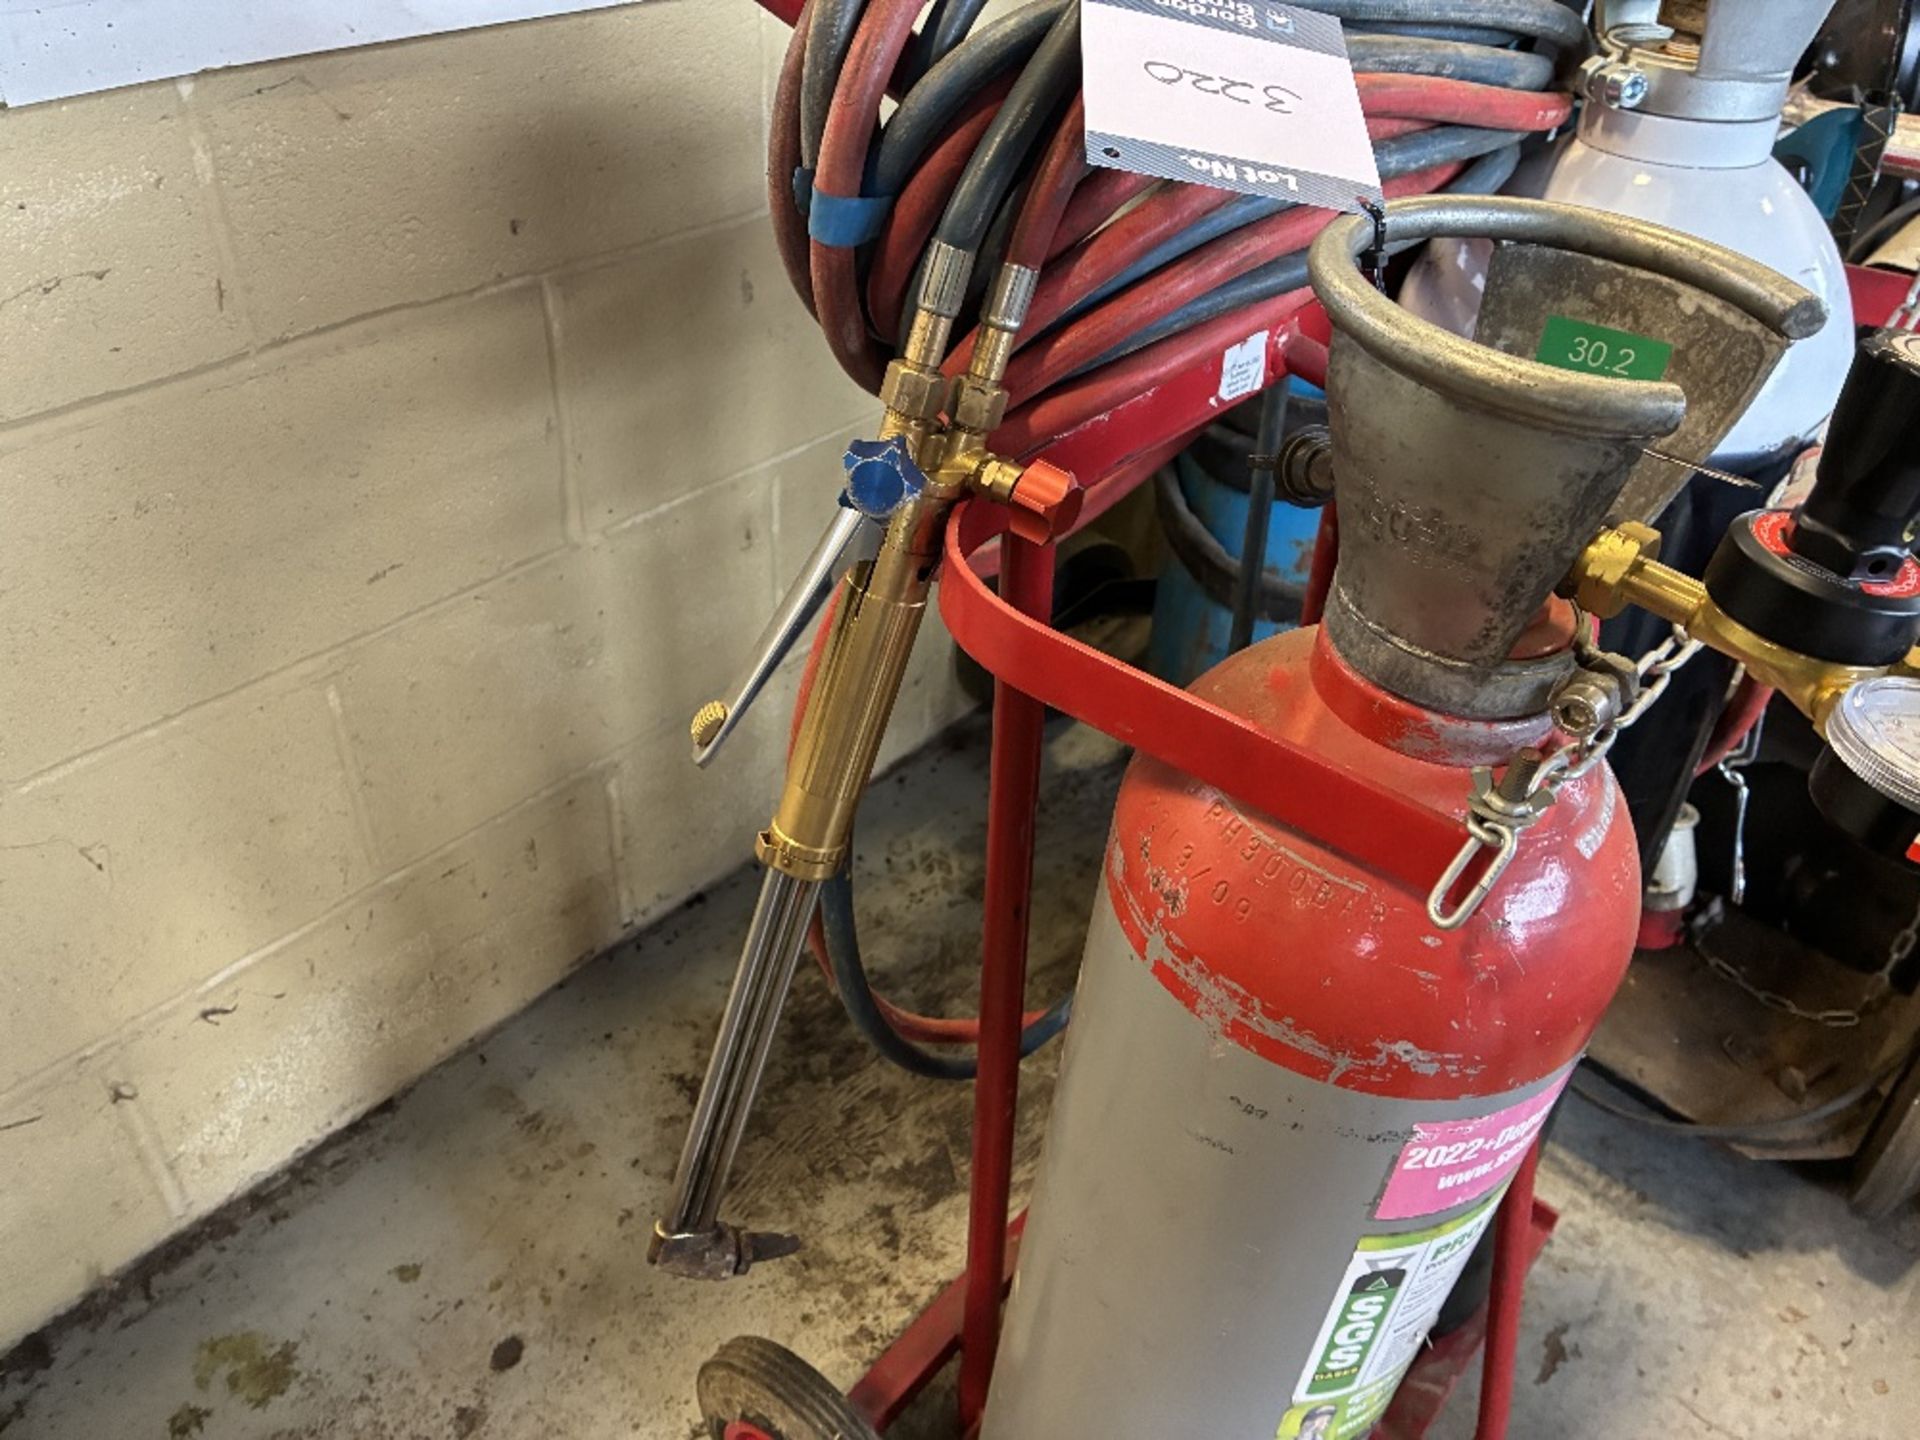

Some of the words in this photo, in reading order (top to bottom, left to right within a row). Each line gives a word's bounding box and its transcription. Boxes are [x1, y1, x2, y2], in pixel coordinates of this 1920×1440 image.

[1155, 0, 1258, 29] Gordon
[1143, 61, 1302, 114] 3220
[1181, 155, 1237, 182] No.
[1244, 167, 1299, 192] Lot
[1568, 337, 1635, 375] 30.2
[1325, 1295, 1386, 1370] SGS
